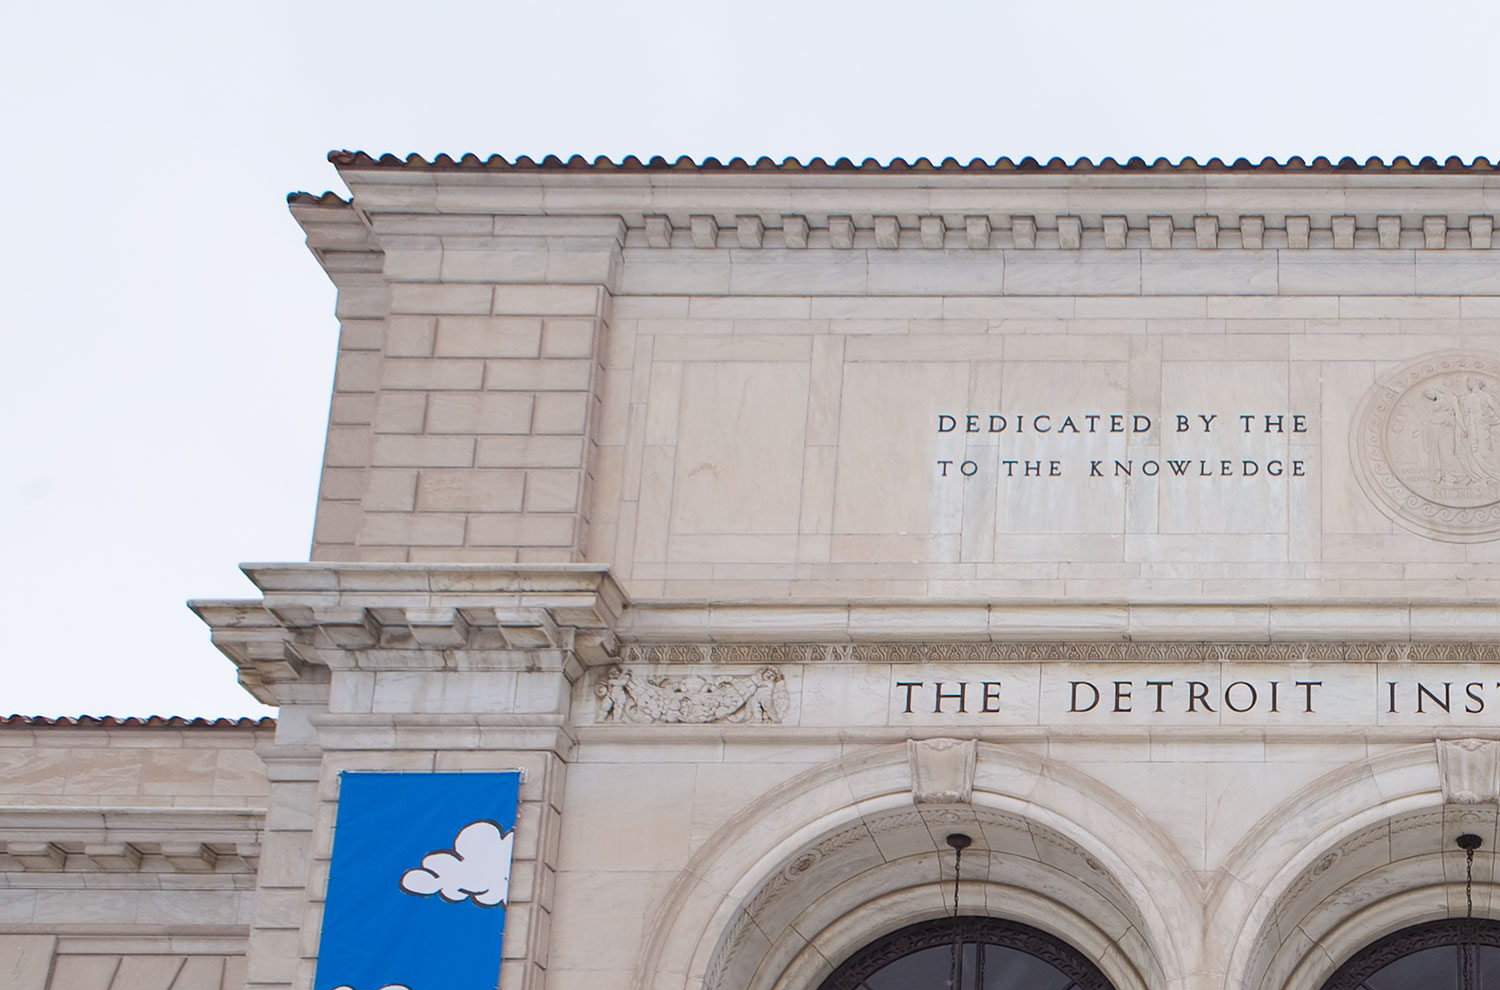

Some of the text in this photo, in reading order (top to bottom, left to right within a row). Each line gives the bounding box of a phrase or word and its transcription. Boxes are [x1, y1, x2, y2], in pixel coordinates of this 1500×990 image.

[938, 414, 1307, 433] DEDICATED BY THE
[937, 460, 1305, 477] TO THE KNOWLEDGE
[896, 681, 1001, 714] THE
[1069, 680, 1323, 713] DETROIT
